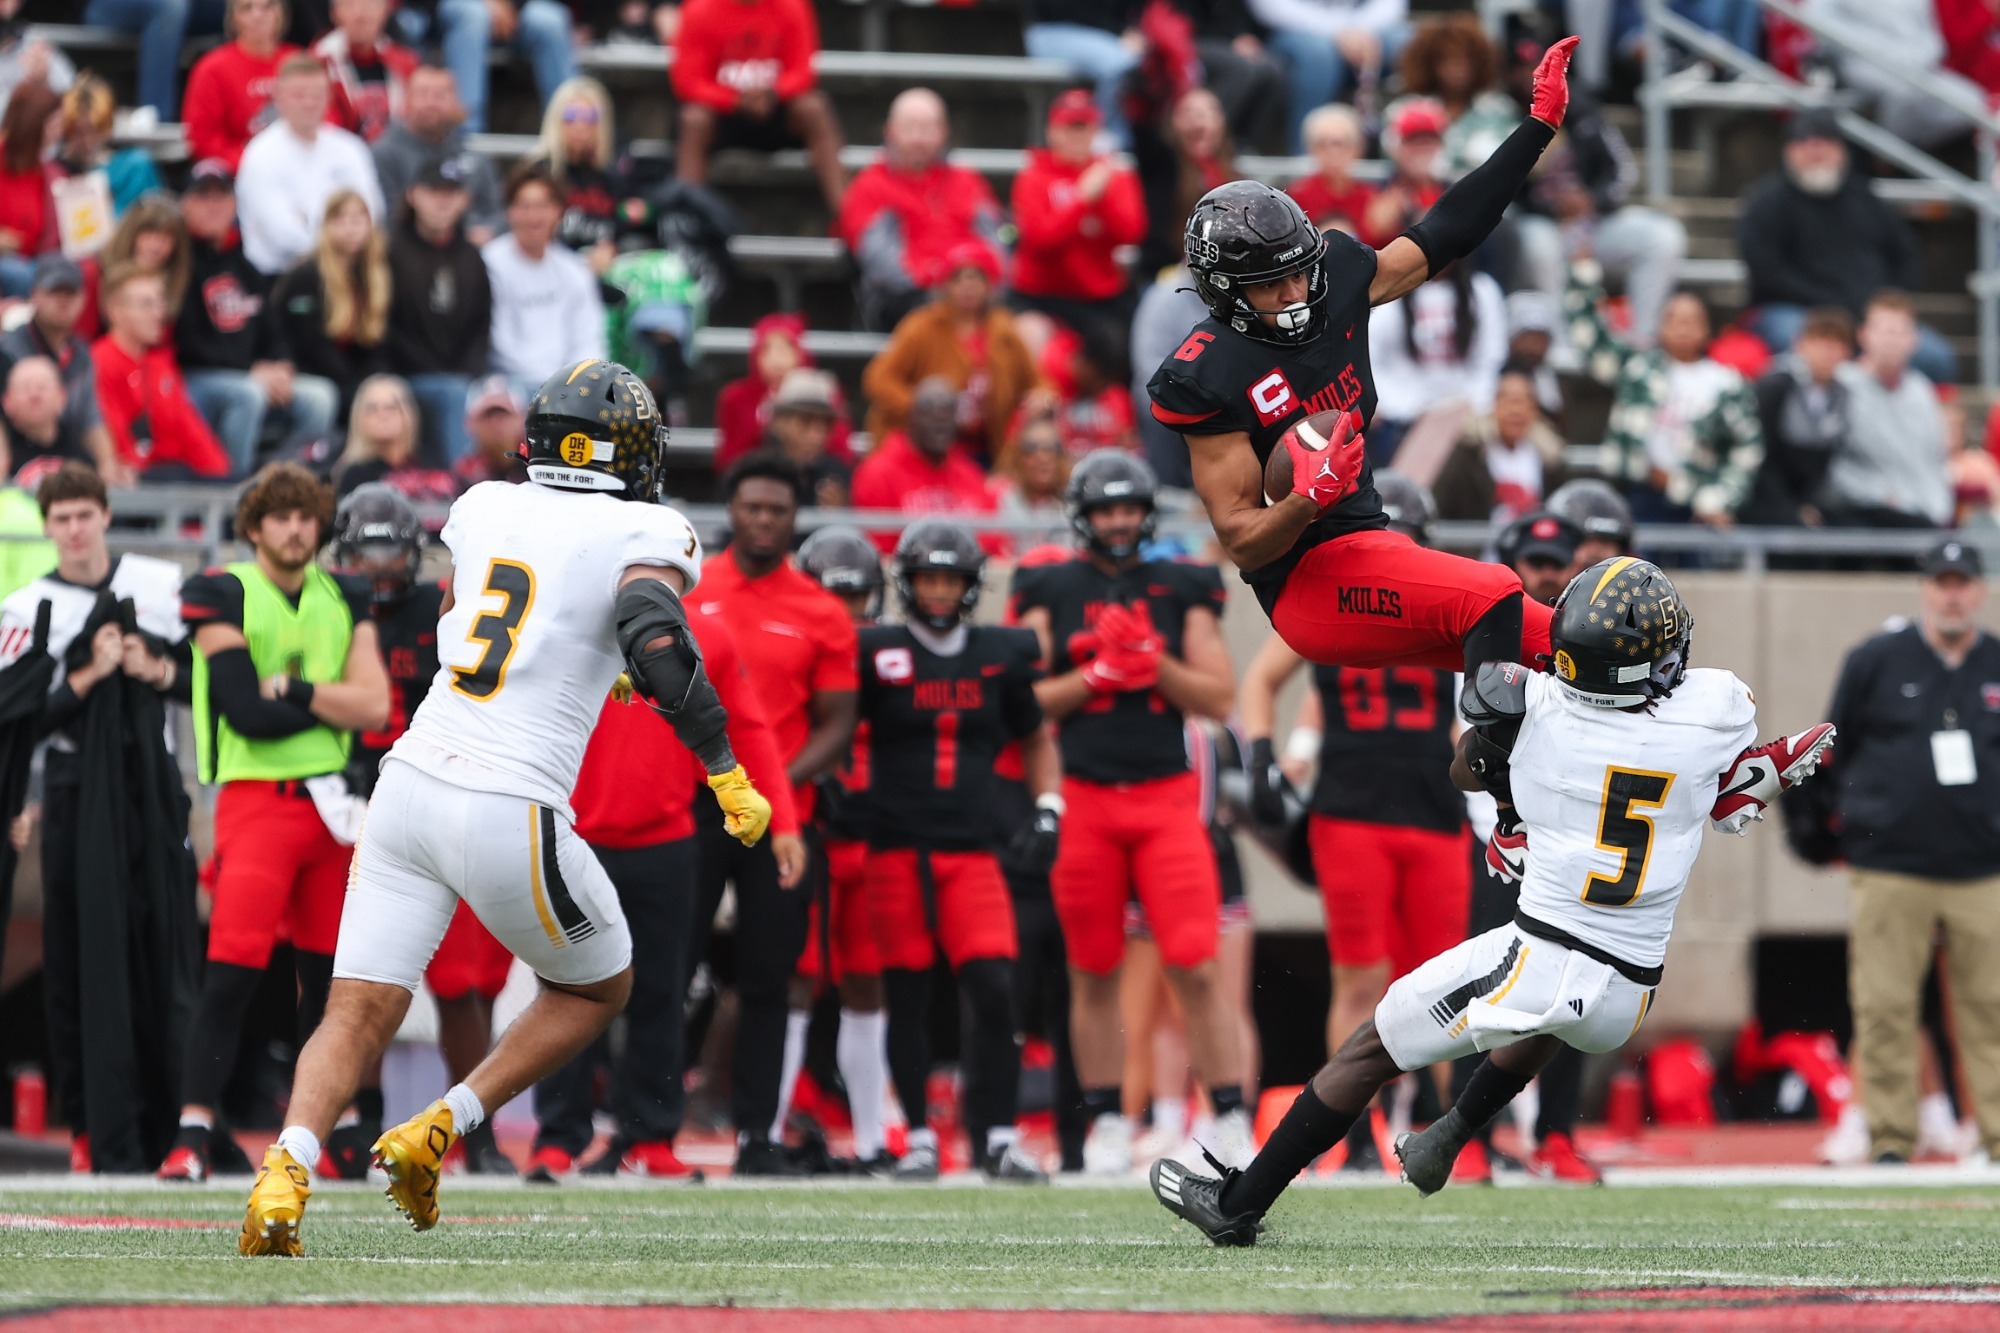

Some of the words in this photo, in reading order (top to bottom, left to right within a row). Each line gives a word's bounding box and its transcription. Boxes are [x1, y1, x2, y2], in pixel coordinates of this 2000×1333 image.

[1279, 246, 1303, 263] MULES
[1310, 263, 1319, 291] Riddell
[1174, 331, 1216, 362] 6
[626, 382, 651, 420] 3
[1251, 373, 1291, 414] C
[1301, 363, 1363, 415] MULES
[569, 437, 586, 450] DH
[569, 451, 584, 463] 23
[557, 472, 571, 482] THE
[574, 474, 595, 485] FORT
[684, 524, 697, 559] 3
[1337, 586, 1402, 618] MULES
[449, 557, 537, 702] 3
[1658, 596, 1678, 640] 5
[1559, 652, 1569, 668] DH
[914, 680, 983, 710] MULES
[1579, 695, 1592, 703] THE
[935, 711, 958, 788] 1
[1580, 764, 1677, 907] 5
